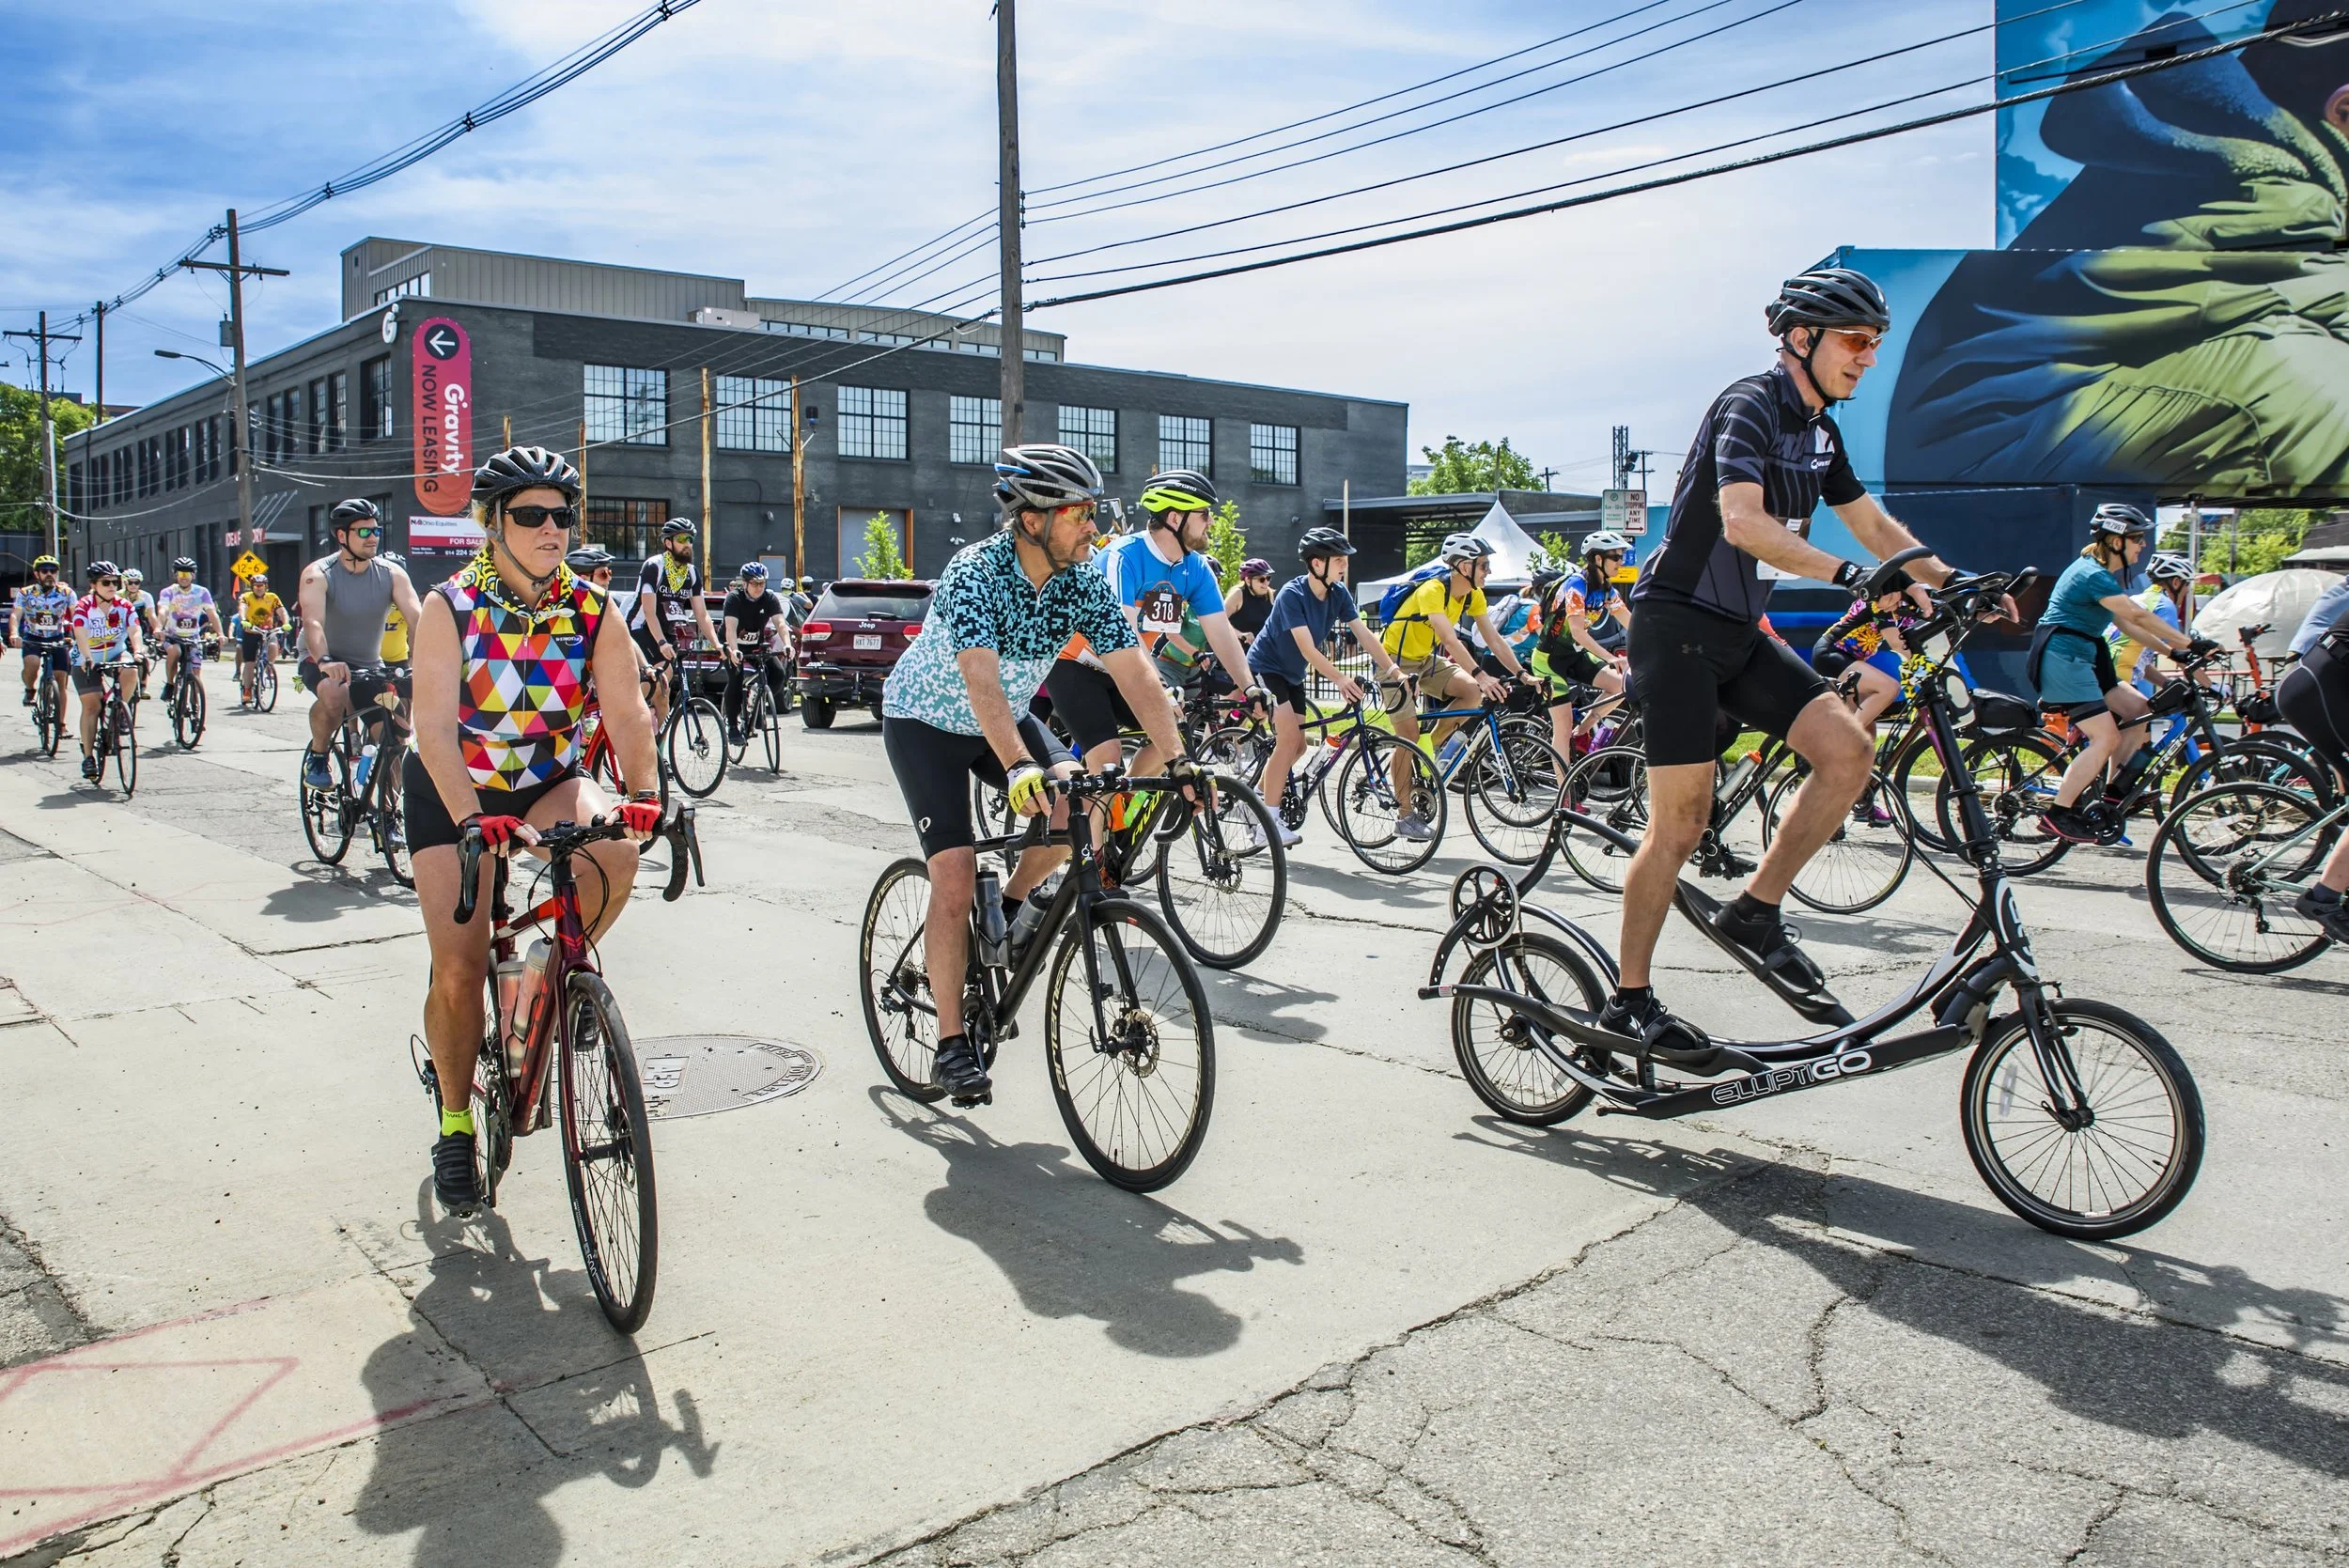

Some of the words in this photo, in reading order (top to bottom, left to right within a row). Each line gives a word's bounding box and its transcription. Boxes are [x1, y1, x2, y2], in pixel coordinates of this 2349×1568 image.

[422, 365, 437, 411] NOW
[423, 416, 439, 492] LEASING
[441, 383, 468, 477] Gravity
[1152, 601, 1174, 620] 318
[2149, 732, 2188, 775] TREK
[1711, 1050, 1873, 1105] ELLIPTIGO
